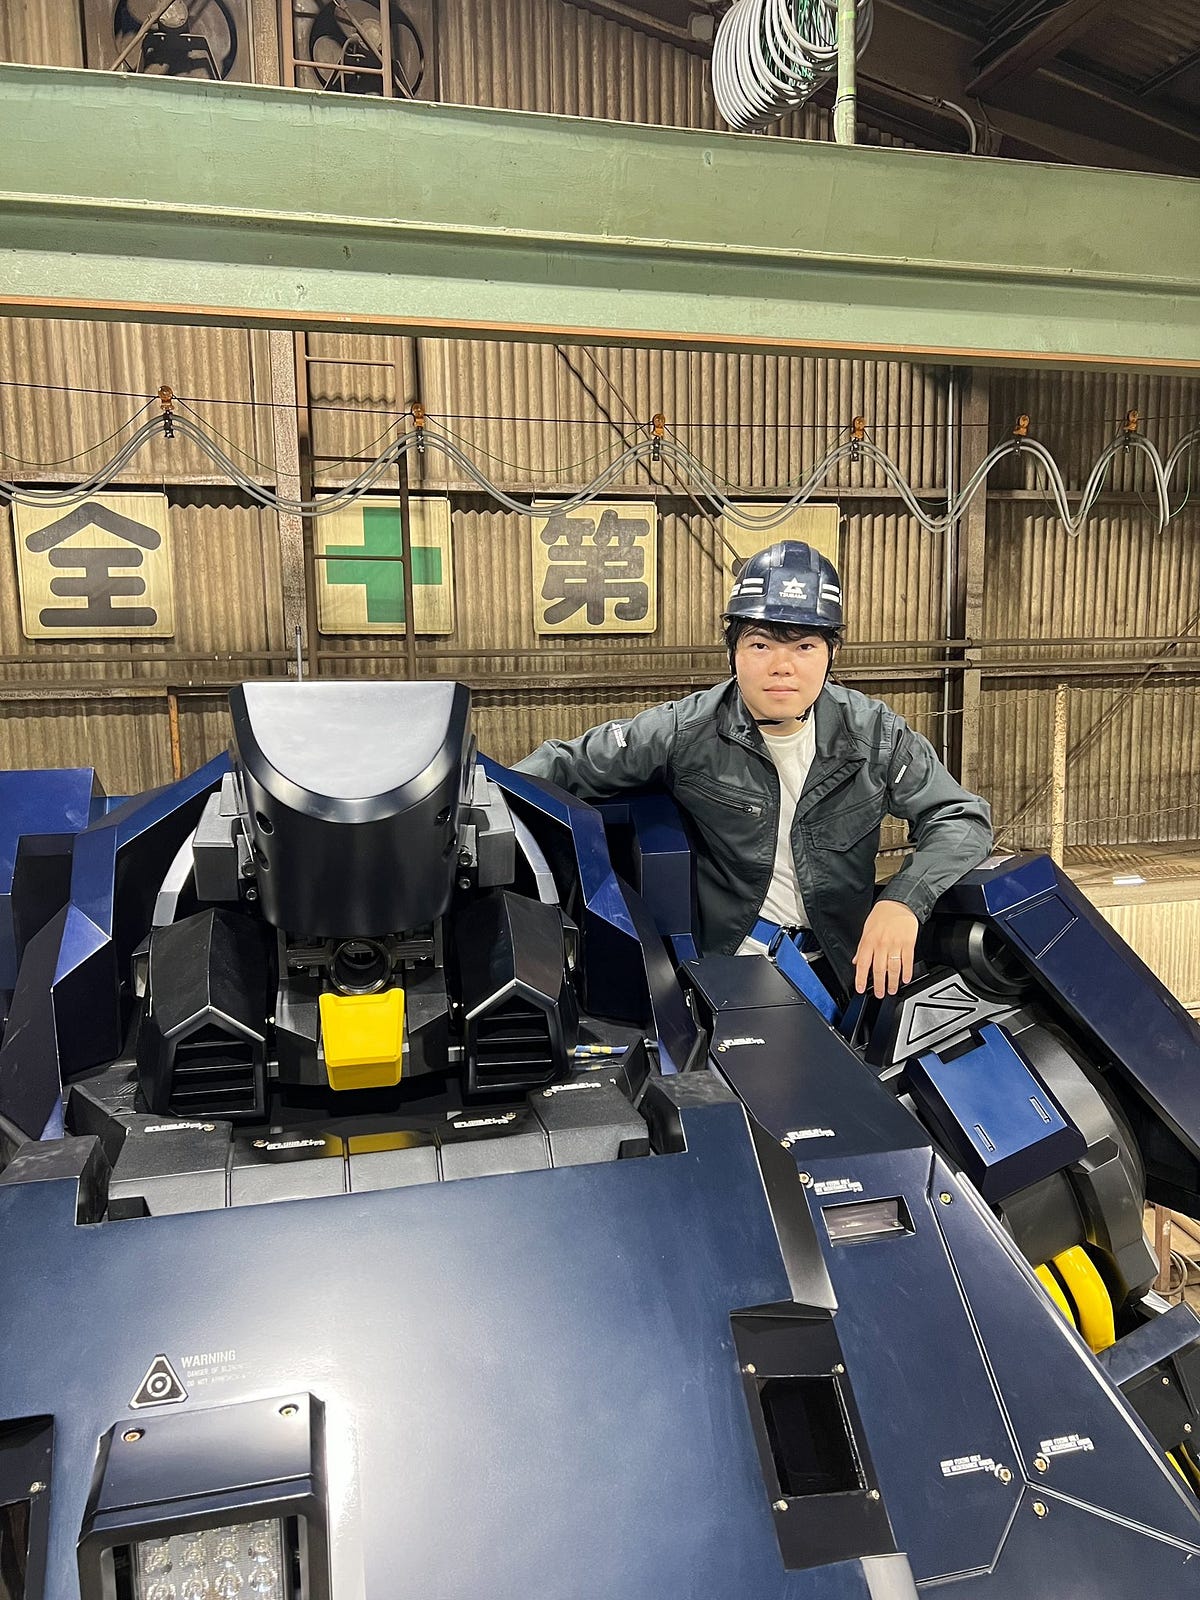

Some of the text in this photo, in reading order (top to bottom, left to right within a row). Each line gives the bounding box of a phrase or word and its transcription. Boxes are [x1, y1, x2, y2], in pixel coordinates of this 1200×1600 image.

[25, 502, 161, 627] 全
[540, 509, 650, 625] 第
[181, 1349, 236, 1369] WARNING
